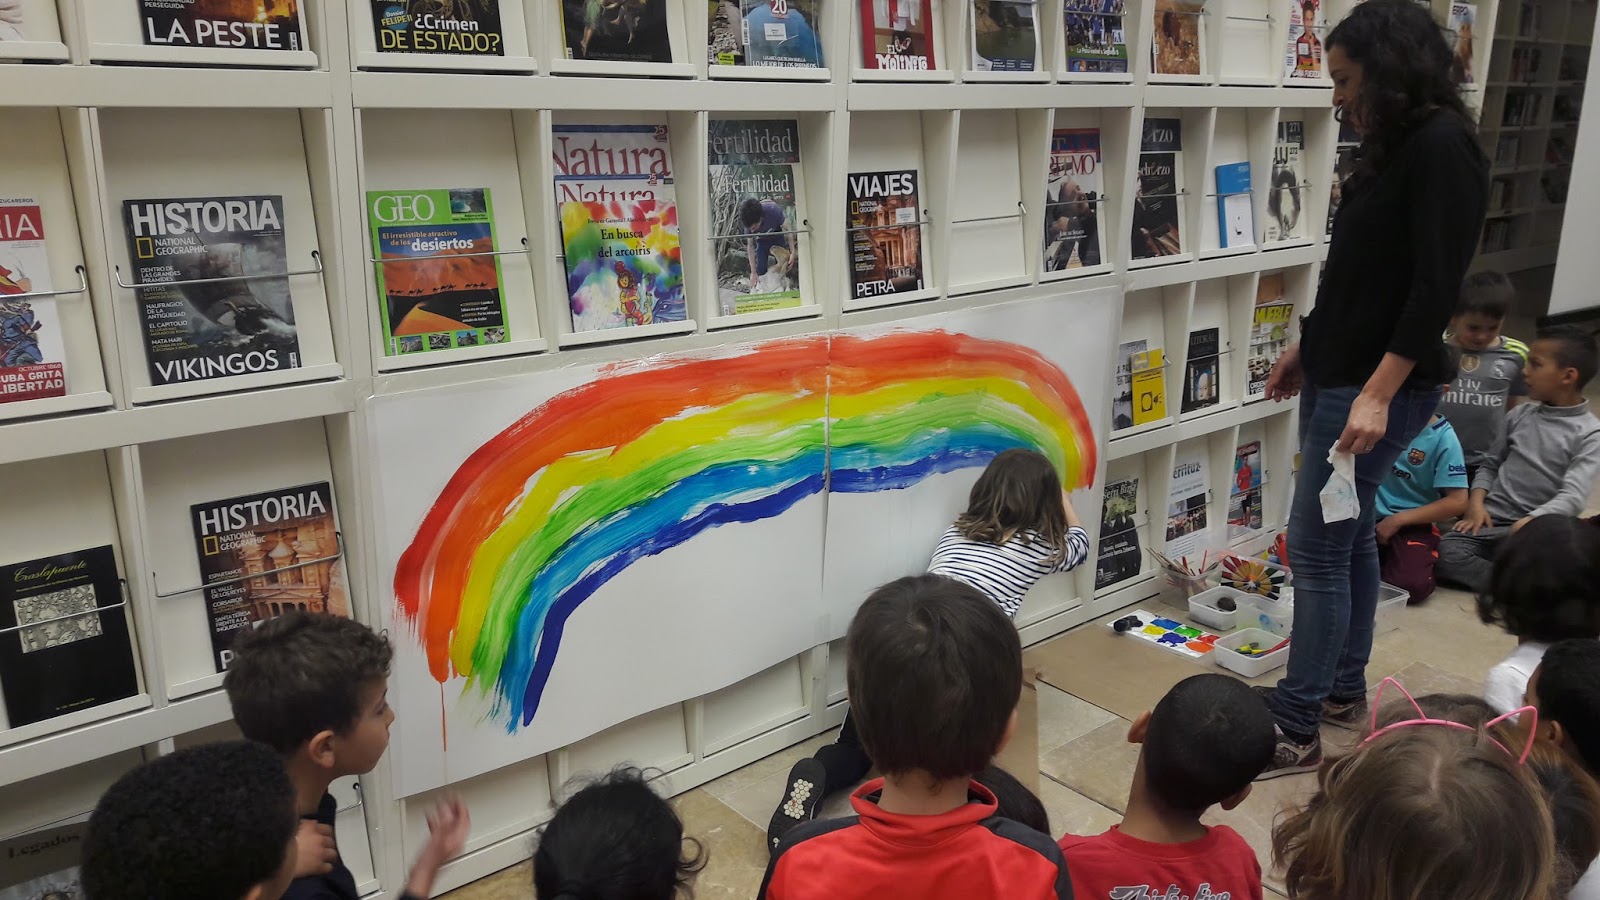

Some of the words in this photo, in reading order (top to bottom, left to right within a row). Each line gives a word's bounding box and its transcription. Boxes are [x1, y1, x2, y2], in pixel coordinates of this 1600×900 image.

[381, 15, 407, 26] FELIPE
[414, 13, 479, 31] ¿Crimen
[147, 17, 191, 43] LA
[195, 19, 282, 48] PESTE
[381, 29, 409, 49] DE
[413, 31, 500, 52] ESTADO?
[708, 128, 793, 154] ertilidad
[553, 137, 671, 176] Natura
[1139, 161, 1170, 176] cherzo
[725, 174, 790, 193] Fertilidad
[849, 173, 914, 198] VIAJES
[373, 194, 435, 222] GEO
[0, 213, 39, 238] IA
[130, 200, 281, 236] HISTORIA
[155, 236, 197, 247] NATIONAL
[390, 231, 427, 239] irresistible
[601, 229, 614, 240] En
[617, 228, 644, 239] busca
[155, 245, 208, 256] GEOGRAPHIC
[411, 237, 474, 252] desiertos
[598, 246, 612, 258] del
[856, 279, 896, 297] PETRA
[146, 301, 183, 309] NAUFRAGIOS
[18, 364, 47, 372] OCTUBRE
[155, 349, 279, 381] VIKINGOS
[0, 374, 25, 383] UBA
[28, 370, 62, 380] GRITA
[1441, 389, 1503, 407] mirates
[199, 490, 326, 536] HISTORIA
[219, 530, 256, 543] NATIONAL
[220, 536, 266, 551] GEOGRAPHIC
[208, 568, 243, 579] ESPARTANOS
[212, 597, 243, 607] CORSARIOS
[215, 615, 232, 623] SANTA
